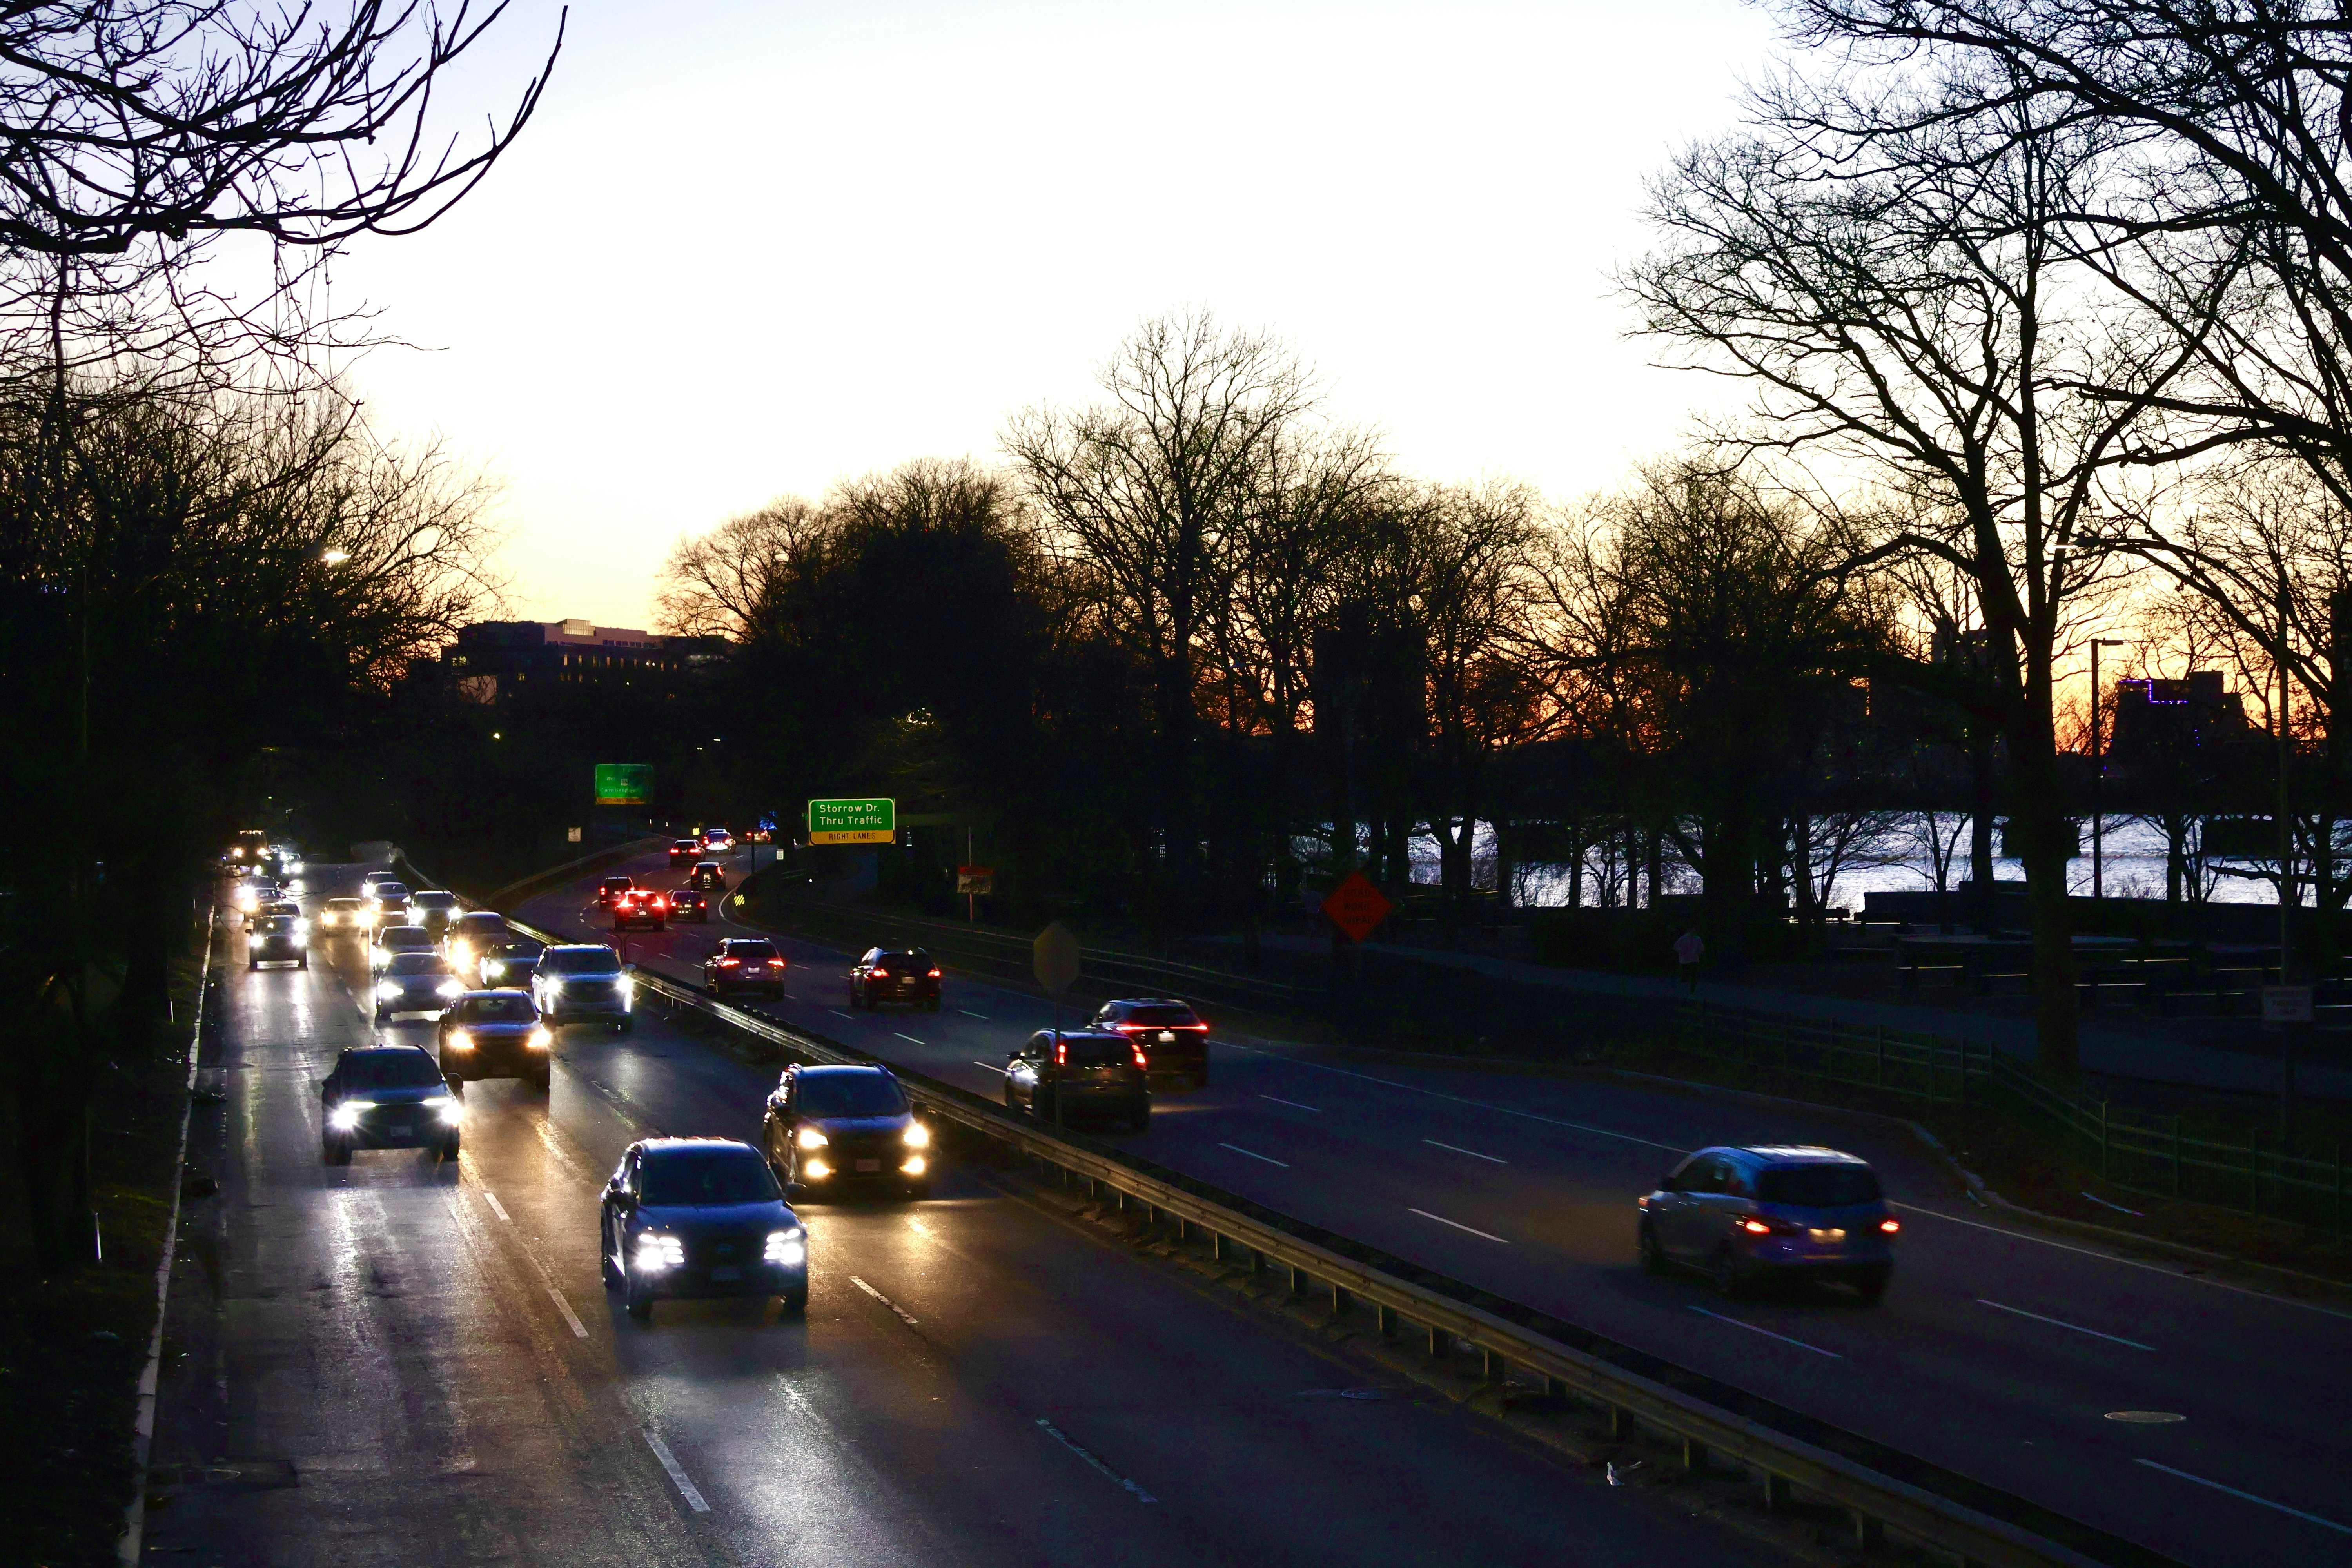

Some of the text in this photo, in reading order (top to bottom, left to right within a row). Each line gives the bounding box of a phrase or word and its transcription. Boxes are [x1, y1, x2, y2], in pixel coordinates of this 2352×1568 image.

[819, 804, 880, 813] Storrow Dr.
[819, 815, 882, 825] Thru Traffic
